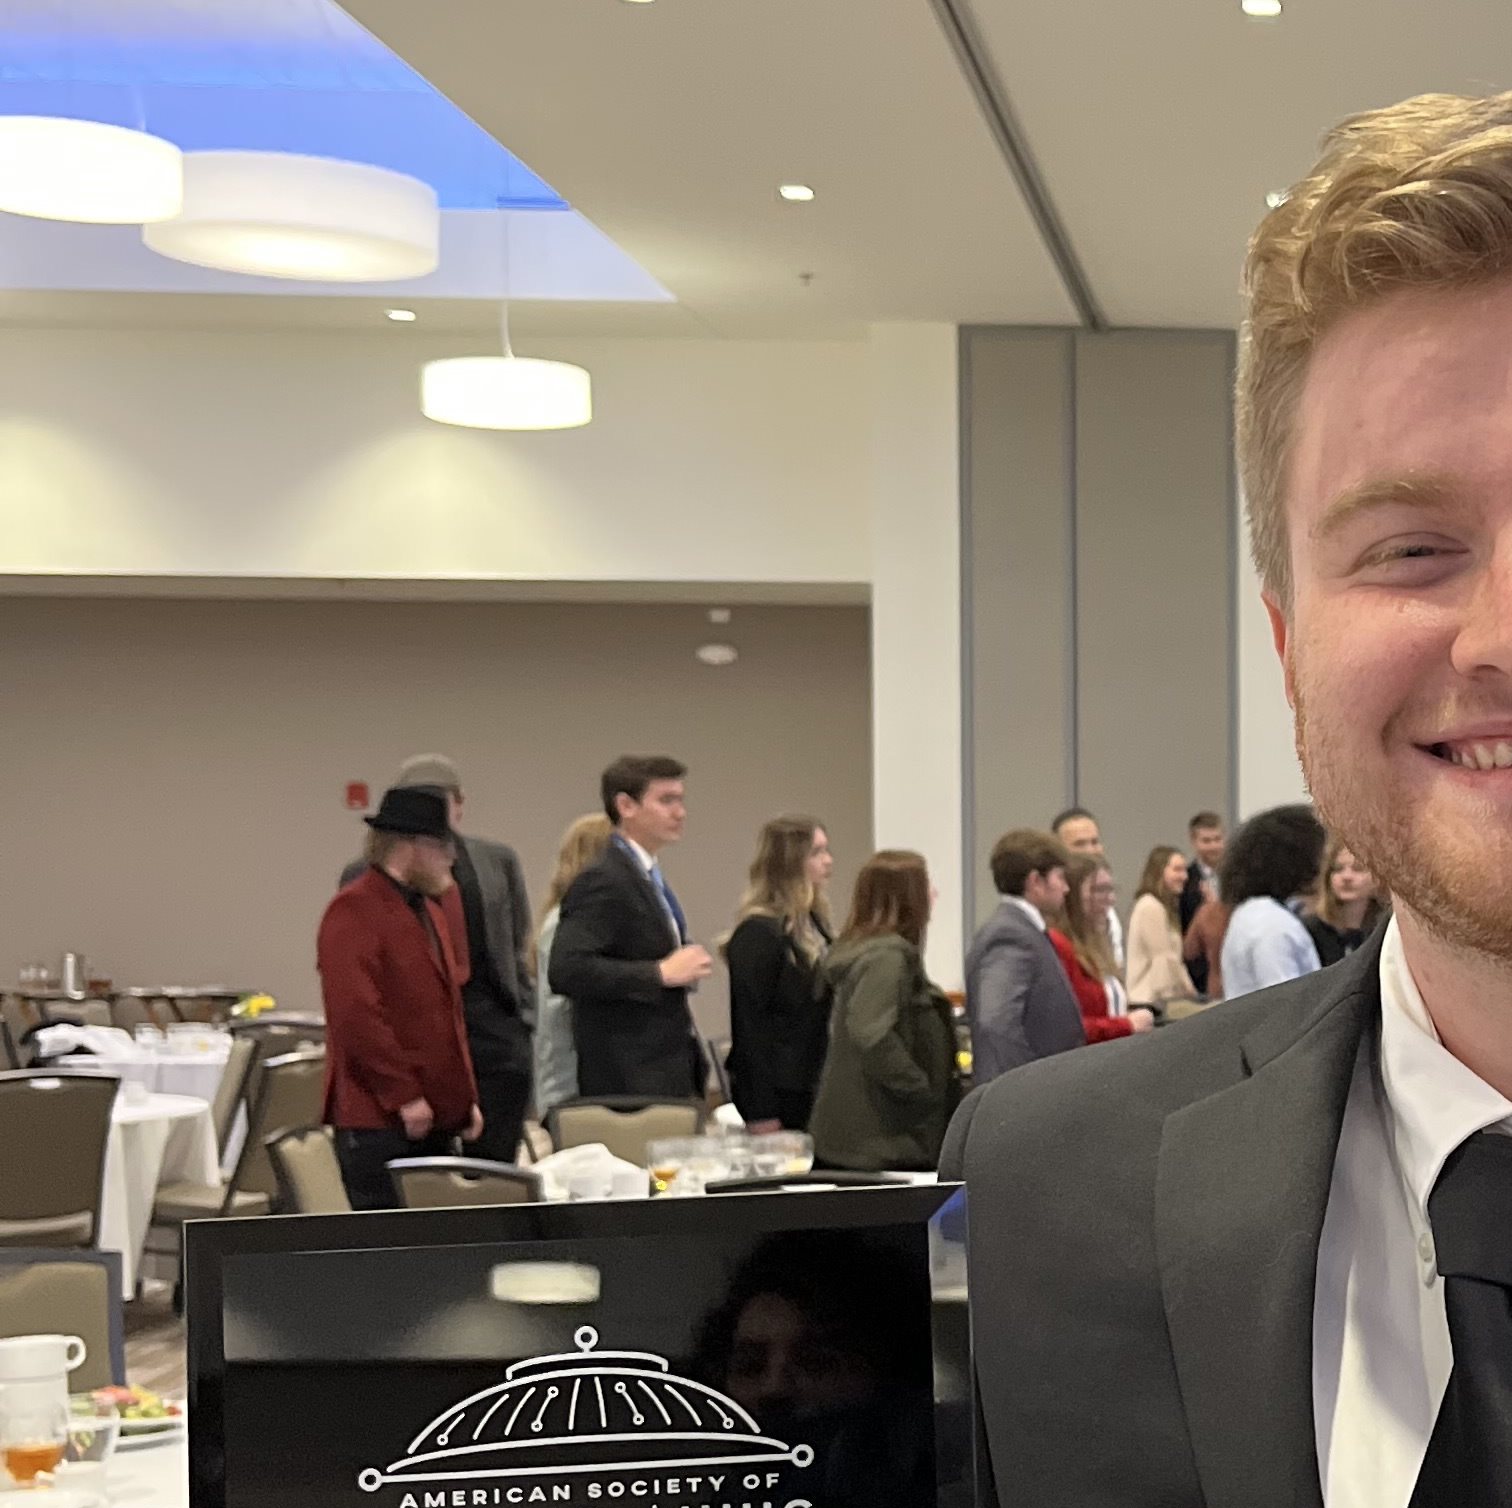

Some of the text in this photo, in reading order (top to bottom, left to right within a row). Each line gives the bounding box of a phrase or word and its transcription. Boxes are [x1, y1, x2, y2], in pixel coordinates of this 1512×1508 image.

[400, 1473, 779, 1508] AMERICAN SOCIETY OF
